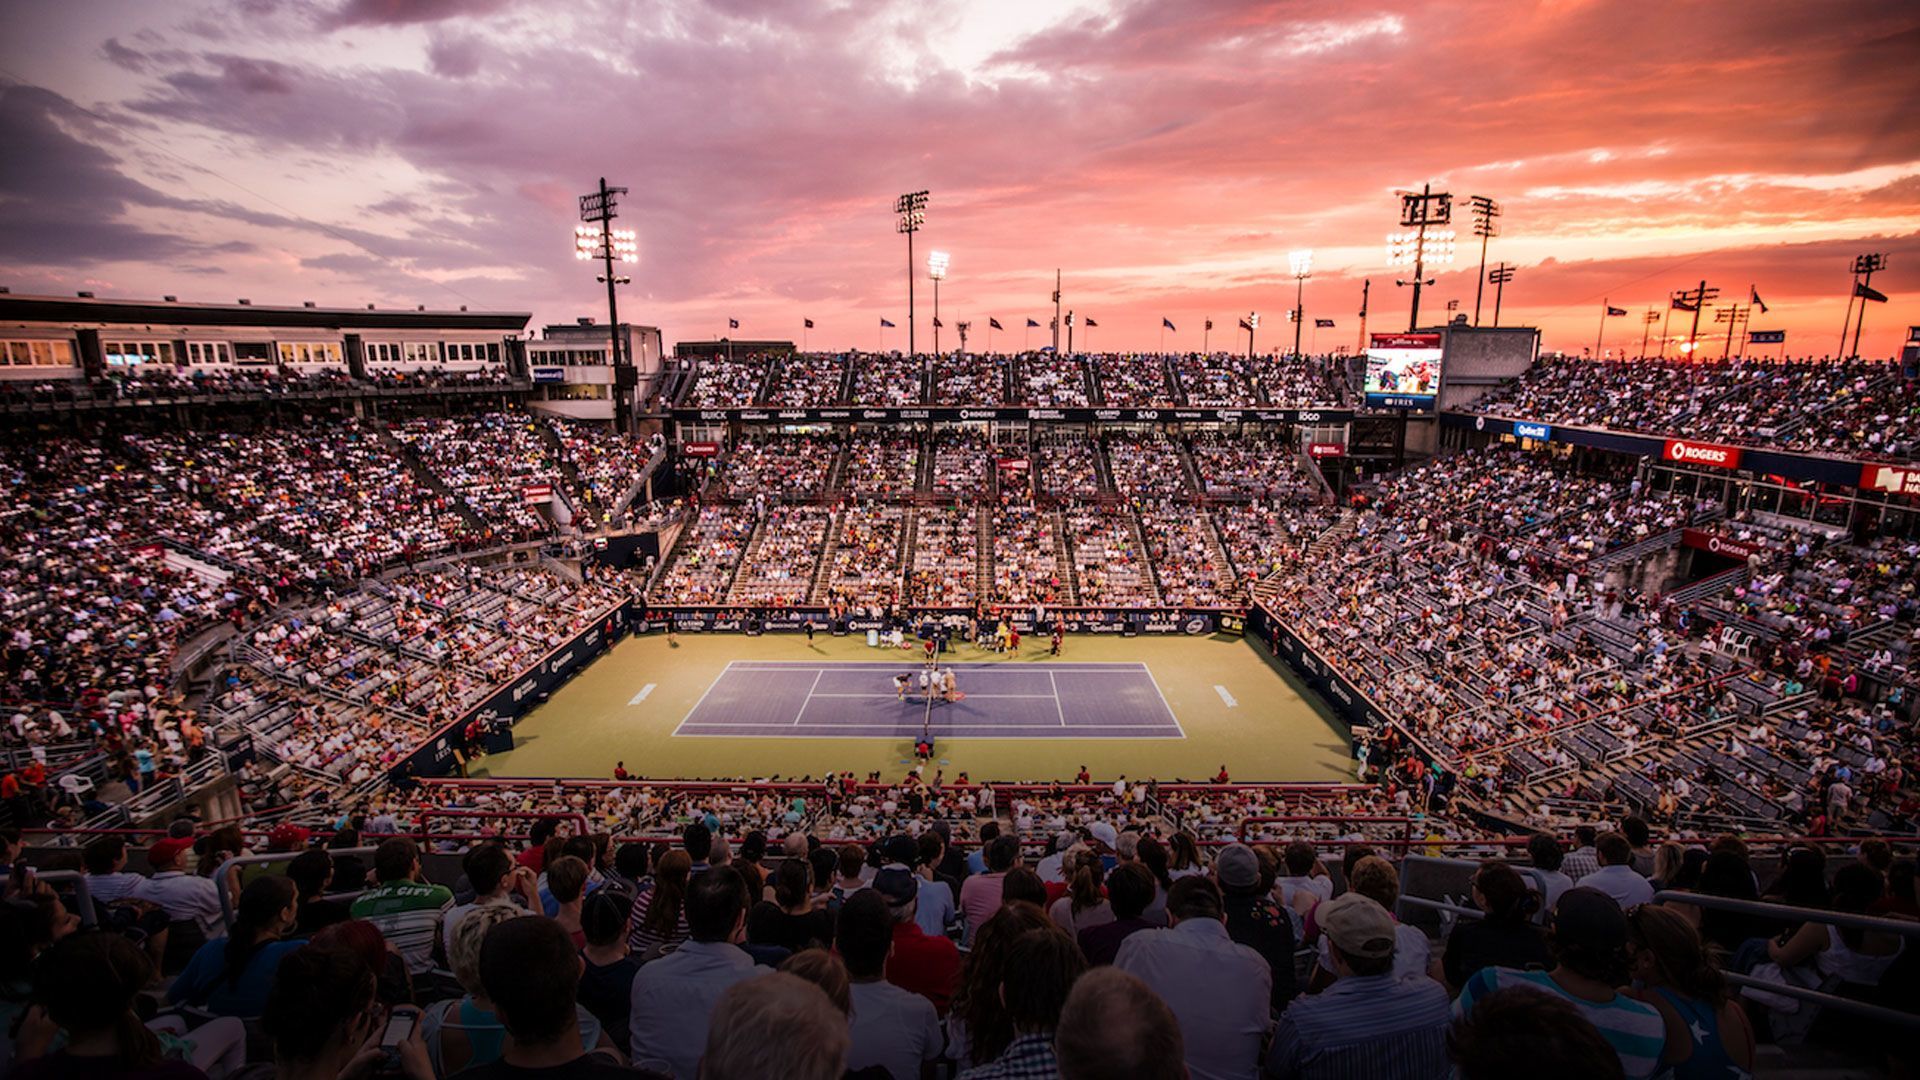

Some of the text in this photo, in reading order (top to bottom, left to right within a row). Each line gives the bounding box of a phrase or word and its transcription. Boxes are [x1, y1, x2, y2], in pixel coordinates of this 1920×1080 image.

[700, 411, 727, 420] BUICK
[1685, 446, 1727, 462] ROGERS
[1720, 542, 1749, 557] ROGERS
[396, 886, 434, 898] CITY
